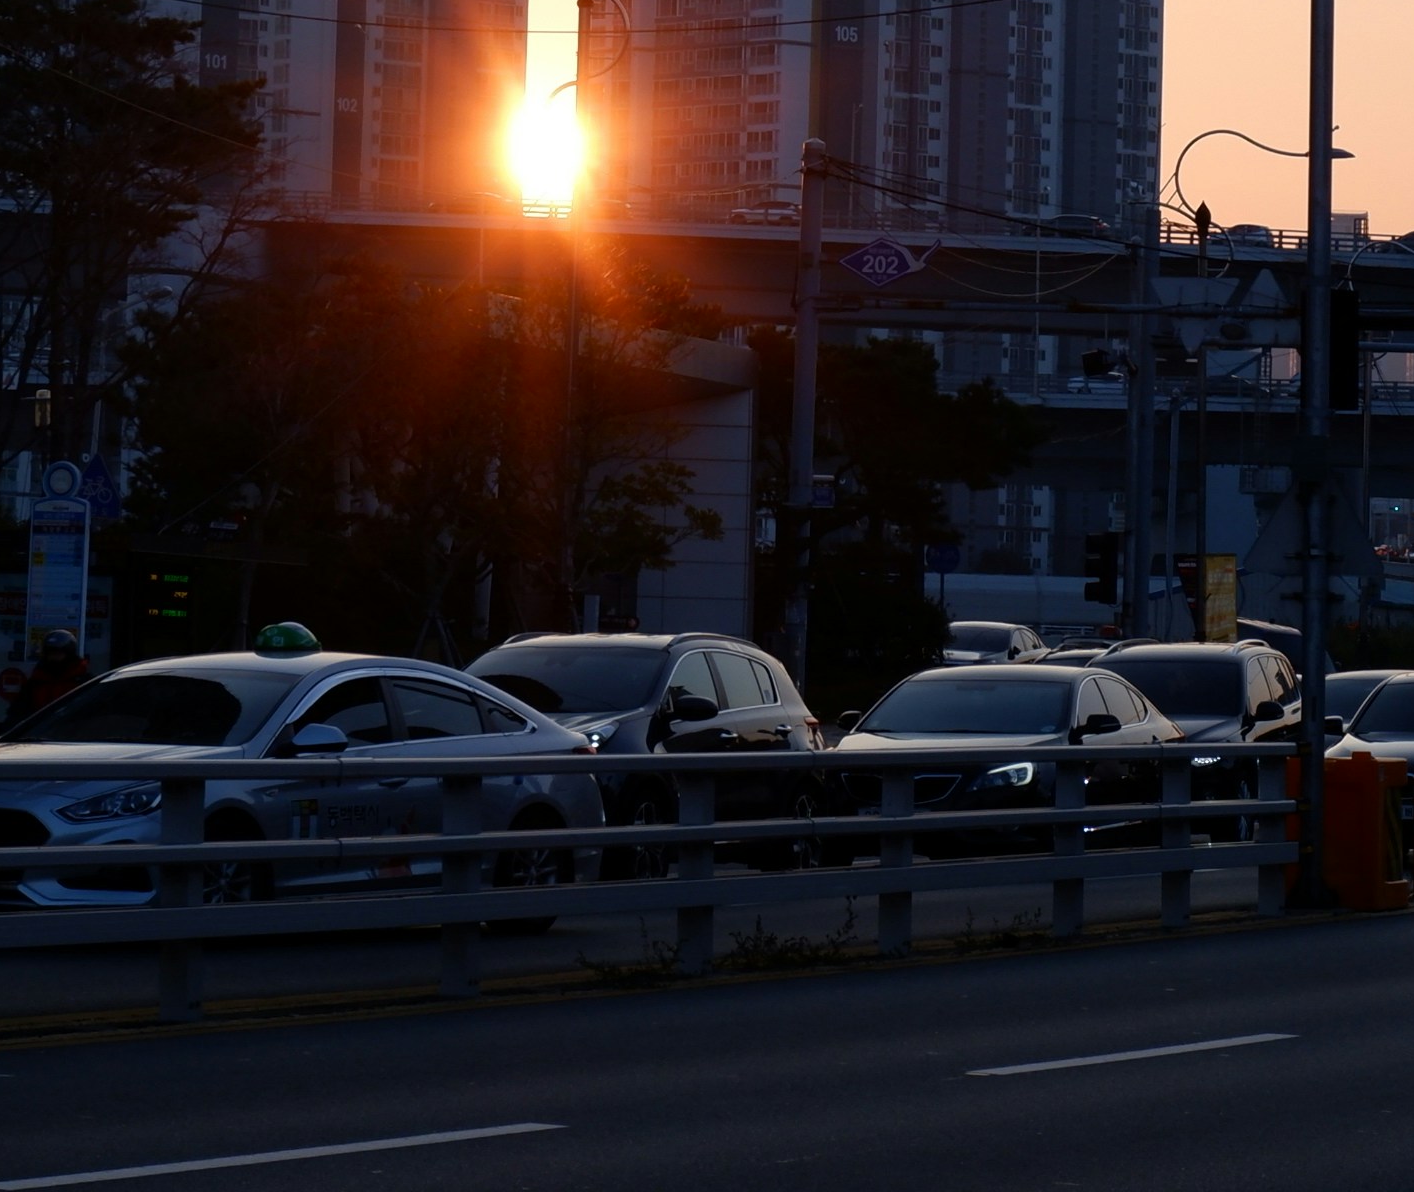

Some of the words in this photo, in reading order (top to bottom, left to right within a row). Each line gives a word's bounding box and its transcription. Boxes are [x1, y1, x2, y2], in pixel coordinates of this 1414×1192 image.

[835, 25, 859, 43] 105
[204, 53, 228, 70] 101
[337, 97, 358, 113] 102
[861, 254, 899, 275] 202
[328, 805, 380, 828] 동백택시
